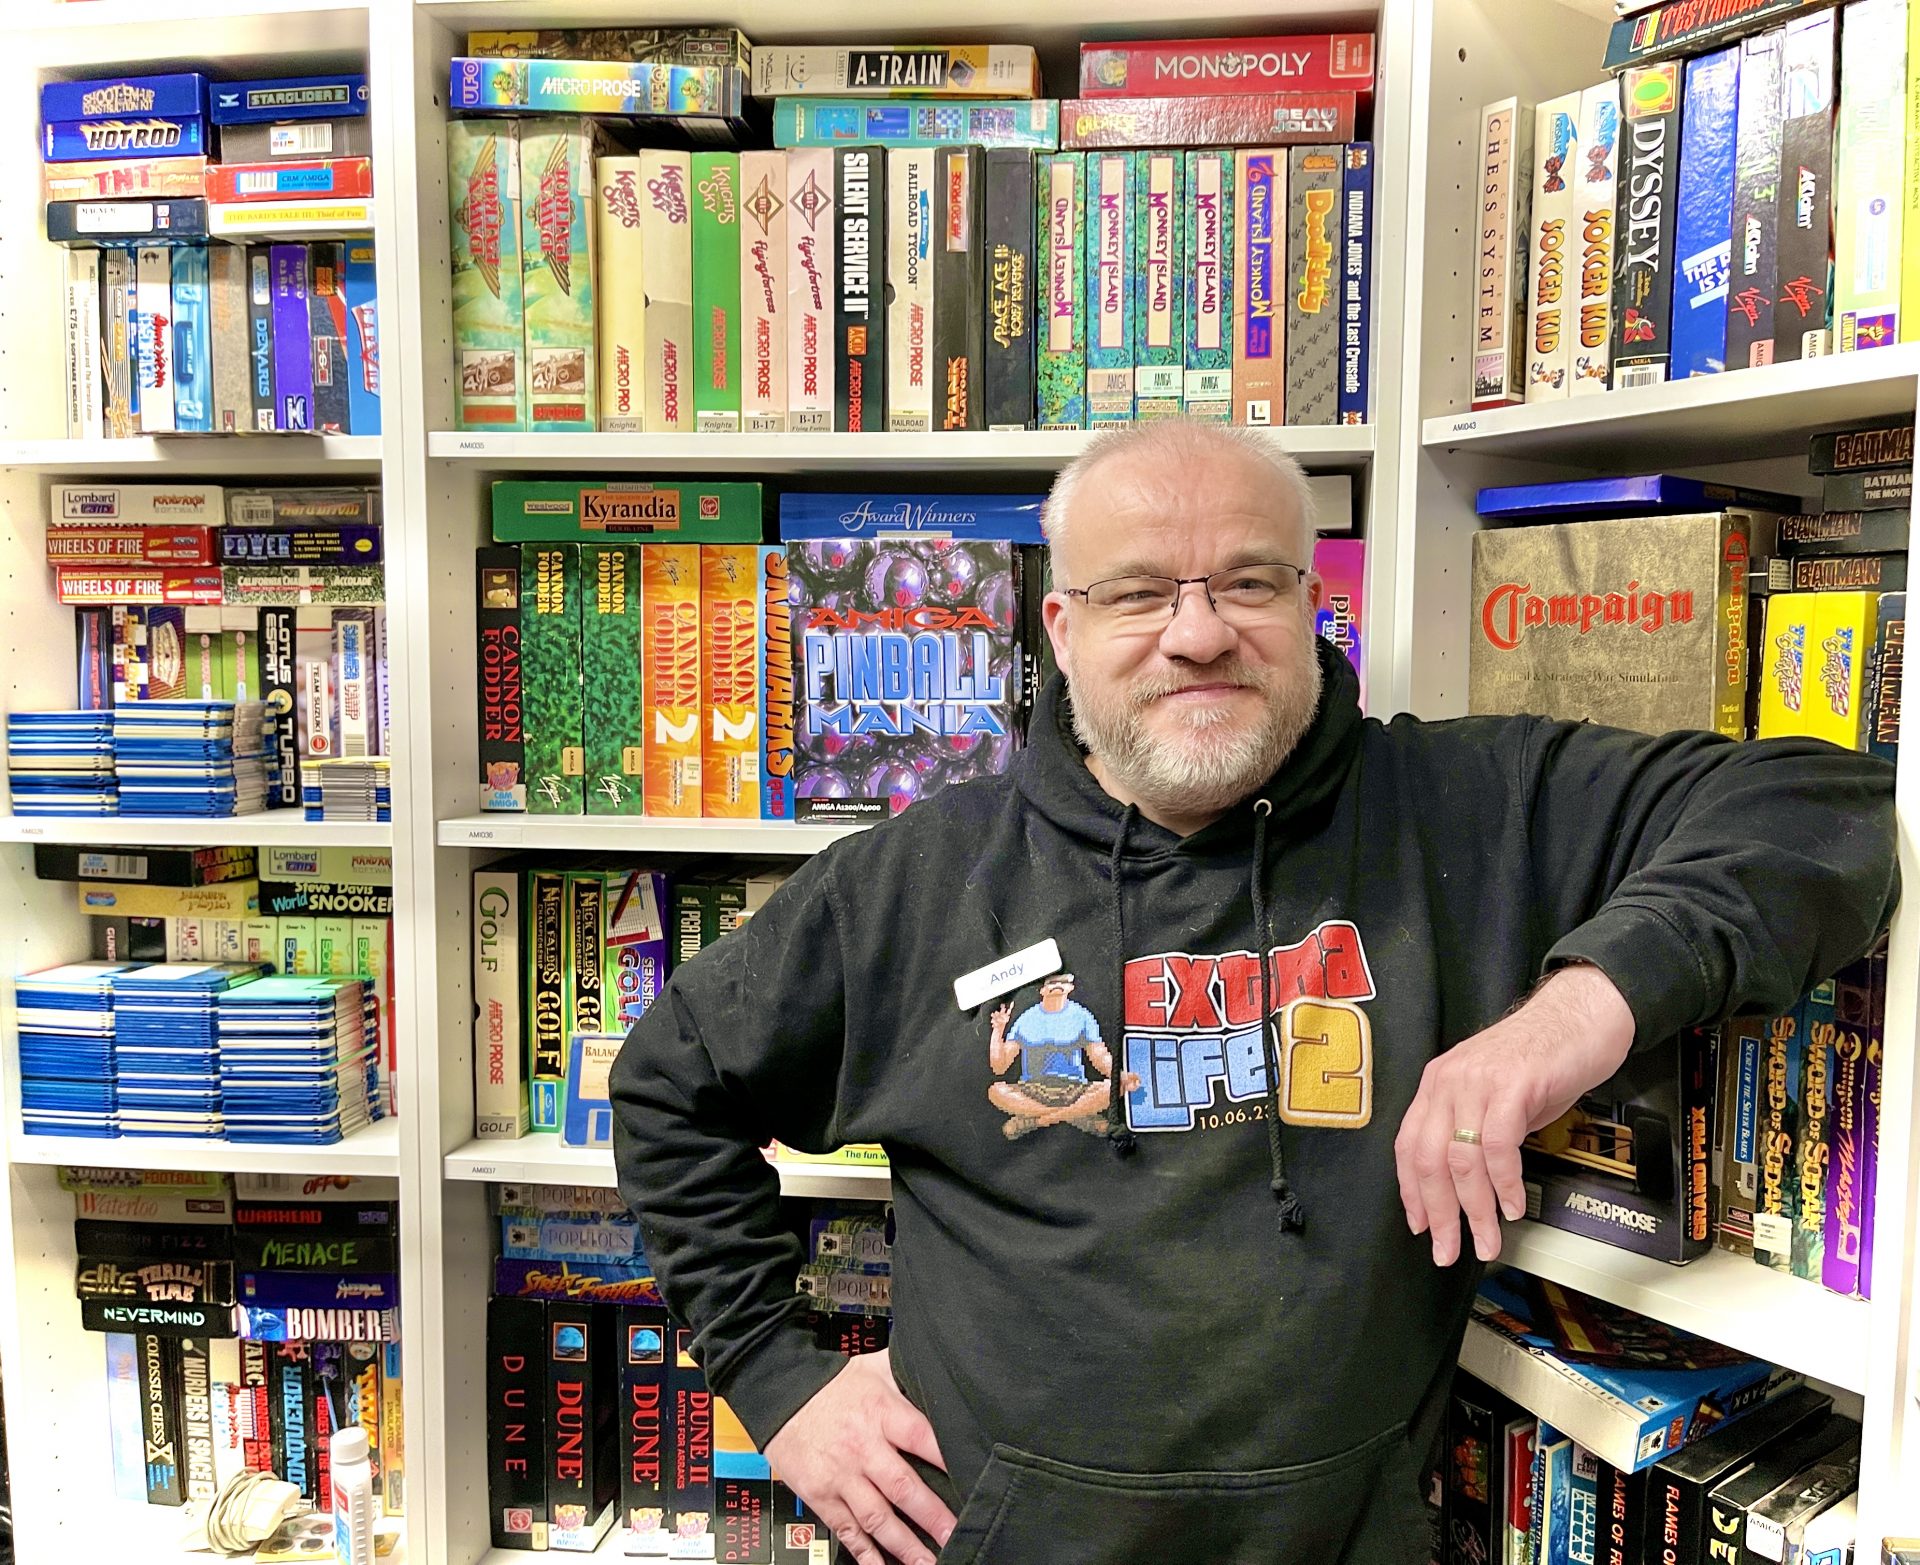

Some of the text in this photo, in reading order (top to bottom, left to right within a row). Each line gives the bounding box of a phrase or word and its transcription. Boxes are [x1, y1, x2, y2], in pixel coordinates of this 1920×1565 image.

[462, 60, 480, 104] UFO
[1155, 51, 1312, 80] MONOPOLY
[251, 88, 333, 105] STARGLIDER
[1273, 107, 1338, 121] BEAU
[88, 125, 181, 150] HOT ROD
[1272, 120, 1338, 134] JOLLY
[94, 165, 151, 194] TNT
[614, 170, 640, 229] KNIGHTS
[843, 152, 869, 216] SILENT
[468, 175, 483, 254] DAWN
[484, 161, 500, 265] PATROL
[540, 174, 554, 252] DAWN
[555, 160, 571, 264] PATROL
[908, 163, 918, 285] RAILROAD TYCOON
[1479, 118, 1501, 343] CHESS SYSTEM
[843, 217, 869, 296] SERVICE
[1053, 197, 1075, 318] MONKEY ISLAND
[1097, 192, 1120, 314] MONKEY ISLAND
[1345, 190, 1364, 394] INDIANA JONES and the Last Crusade
[1535, 218, 1565, 354] SOCCER KID
[1580, 208, 1612, 349] SOCCER KID
[1699, 276, 1715, 293] IS
[255, 318, 270, 397] DENARIS
[946, 356, 961, 430] TANK
[960, 357, 968, 428] PLATOON
[609, 420, 637, 430] Knights
[704, 420, 732, 429] Knights
[752, 419, 776, 429] B-17
[799, 414, 823, 424] B-17
[891, 419, 924, 428] RAILROAD
[1452, 421, 1478, 432] AMI043
[1834, 427, 1915, 469] BATMA
[68, 491, 116, 504] Lombard
[1863, 473, 1912, 489] BATMAN
[1865, 487, 1911, 500] THE MOVIE
[583, 495, 677, 522] Kyrandia
[838, 500, 977, 532] Award Winners
[62, 579, 163, 595] WHEELS OF FIRE
[333, 575, 373, 587] ACCOLADE
[537, 552, 550, 614] FODDER
[549, 551, 564, 614] CANNON
[1796, 557, 1882, 589] BATMAN
[806, 606, 998, 630] AMIGA
[1481, 580, 1695, 650] Campaign
[265, 613, 278, 686] ESPRIT
[277, 613, 292, 684] LOTUS
[764, 550, 795, 778] SKIDMARKS
[804, 632, 1006, 704] PINBALL
[311, 666, 321, 734] TEAM SUZUKI
[483, 629, 500, 742] FODDER
[499, 624, 521, 743] CANNON
[806, 703, 1007, 736] MANIA
[277, 717, 296, 803] TURBO
[537, 773, 571, 808] Virgin
[811, 802, 881, 813] AMIGA A1200/A4000
[273, 850, 317, 861] Lombard
[272, 893, 308, 912] World
[295, 881, 374, 895] Steve Davis
[542, 886, 560, 931] NICK
[989, 961, 1025, 986] Andy
[536, 991, 561, 1069] GOLF
[1278, 996, 1373, 1129] 2
[1804, 1021, 1836, 1118] SWORD
[1834, 1031, 1863, 1130] Dungeon
[479, 1122, 513, 1133] GOLF
[1742, 1100, 1752, 1128] SILVER
[845, 1150, 878, 1161] The fun
[1740, 1128, 1750, 1160] BLADES
[1691, 1105, 1708, 1241] GRAND PRIX
[1800, 1141, 1830, 1232] SODAN
[237, 1210, 322, 1224] WARHEAD
[137, 1262, 204, 1287] THRILL
[260, 1240, 359, 1267] MENACE
[147, 1283, 195, 1302] TIME
[523, 1270, 658, 1300] STREET FIGHTER
[104, 1307, 206, 1327] NEVERMIND
[287, 1308, 383, 1342] BOMBER
[145, 1335, 175, 1465] COLOSSUS CHESS X
[183, 1356, 212, 1480] MURDERS IN SPACE
[556, 1380, 584, 1481] DUNE
[632, 1383, 660, 1484] DUNE
[689, 1391, 710, 1484] DUNE II
[741, 1489, 750, 1557] BATTLE FOR
[751, 1497, 760, 1548] ARRAKIS
[1610, 1470, 1626, 1546] LAMES OF
[1663, 1484, 1680, 1544] FLAMES
